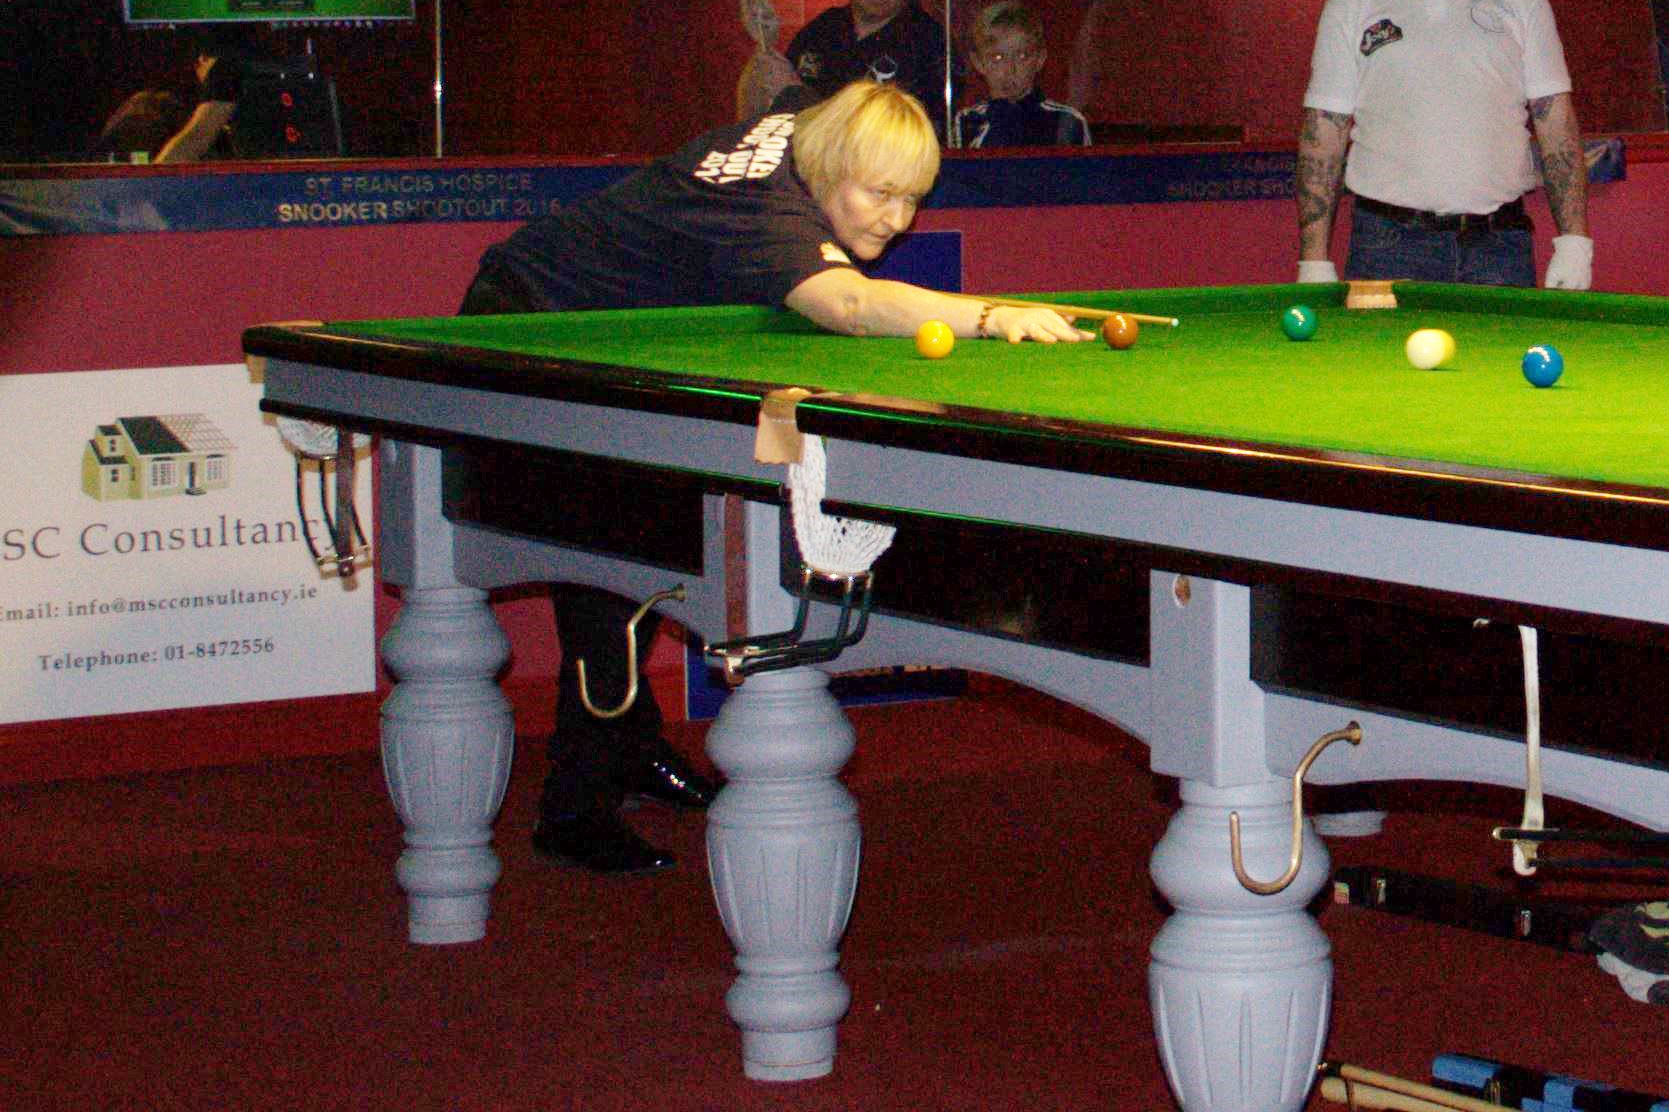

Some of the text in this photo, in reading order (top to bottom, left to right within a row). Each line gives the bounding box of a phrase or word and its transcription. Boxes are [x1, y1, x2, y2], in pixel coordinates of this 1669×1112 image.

[340, 174, 435, 194] FRANCIS
[441, 172, 534, 192] HOSPICE
[277, 201, 388, 223] SNOOKER
[3, 514, 335, 561] SC Consultan
[68, 583, 318, 617] info@mscconsultancy.ie
[39, 637, 275, 672] Telephone: 01-8472556
